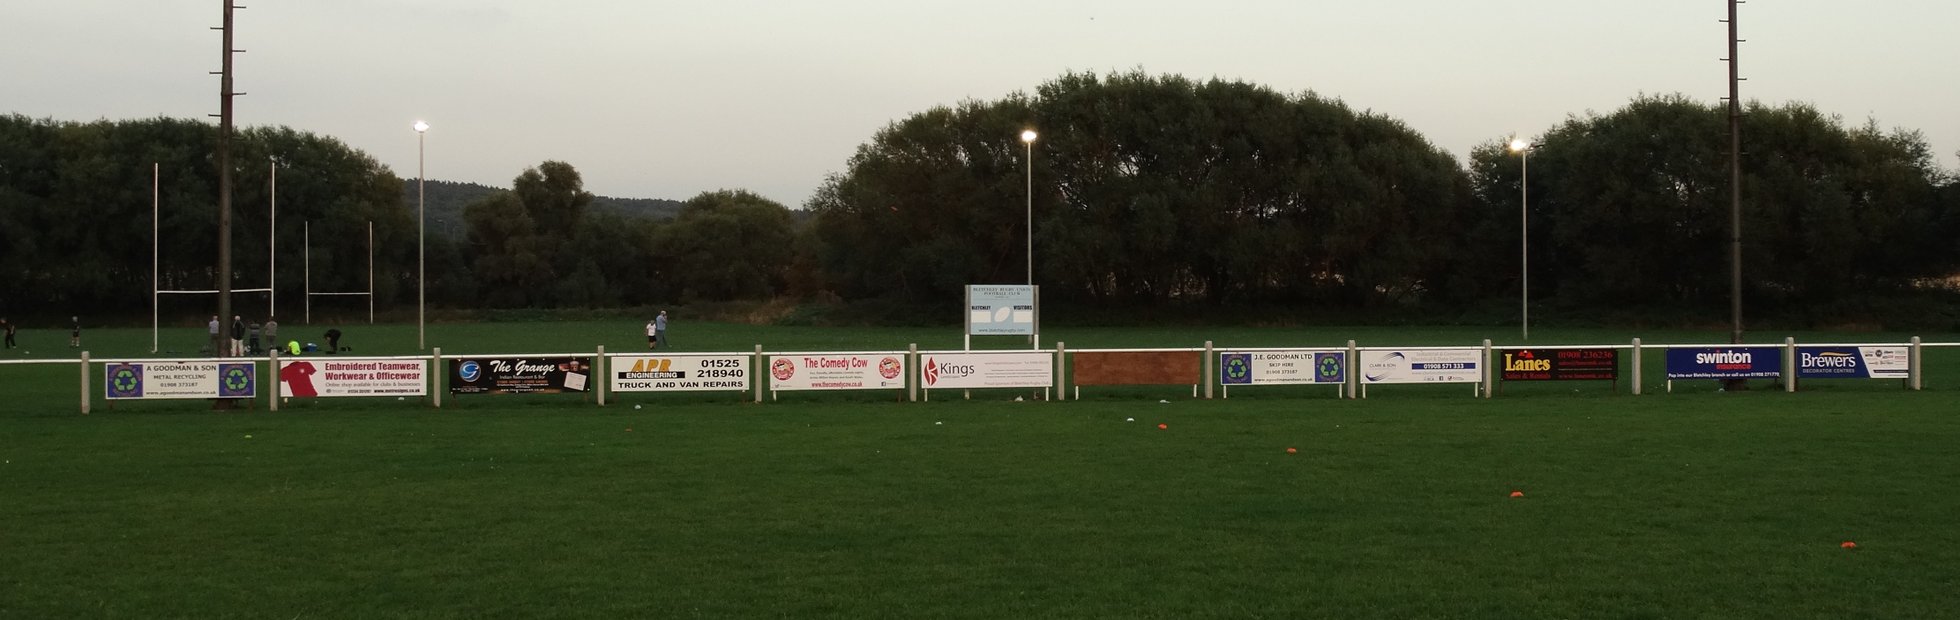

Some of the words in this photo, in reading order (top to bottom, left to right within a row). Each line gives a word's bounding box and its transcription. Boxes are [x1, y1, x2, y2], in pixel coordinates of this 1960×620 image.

[1505, 354, 1550, 371] Lanes
[1696, 350, 1751, 364] swinton
[1801, 352, 1856, 368] Brewers
[378, 362, 420, 371] Teamwear,
[490, 360, 511, 373] The
[515, 360, 555, 376] Grange
[631, 359, 672, 372] APR
[701, 360, 740, 368] 01525
[804, 358, 818, 368] The
[820, 358, 850, 370] Comedy
[852, 358, 868, 368] Cow
[940, 362, 974, 377] Kings
[376, 372, 420, 380] Officewear
[697, 370, 744, 378] 218940
